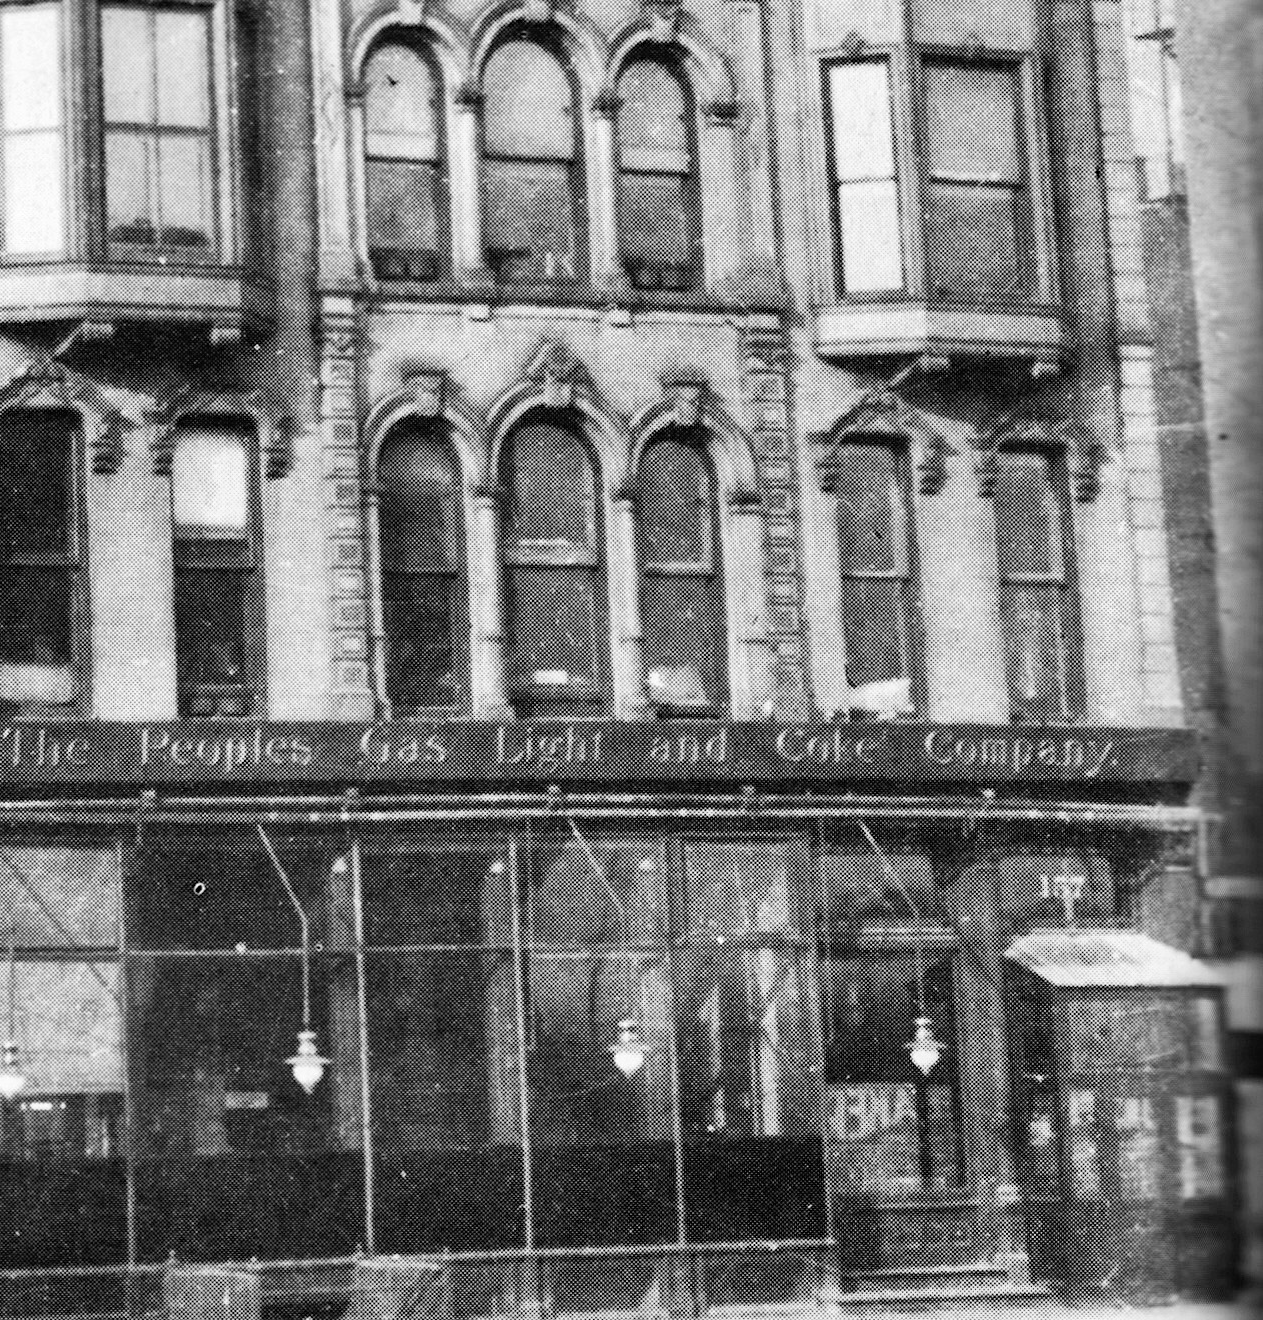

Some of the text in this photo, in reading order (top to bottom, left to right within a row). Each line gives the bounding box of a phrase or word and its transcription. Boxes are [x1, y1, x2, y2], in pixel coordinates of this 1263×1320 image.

[3, 727, 90, 767] The
[139, 728, 312, 772] Peoples
[359, 727, 447, 766] Gas
[496, 728, 603, 773] Light
[651, 729, 728, 762] and
